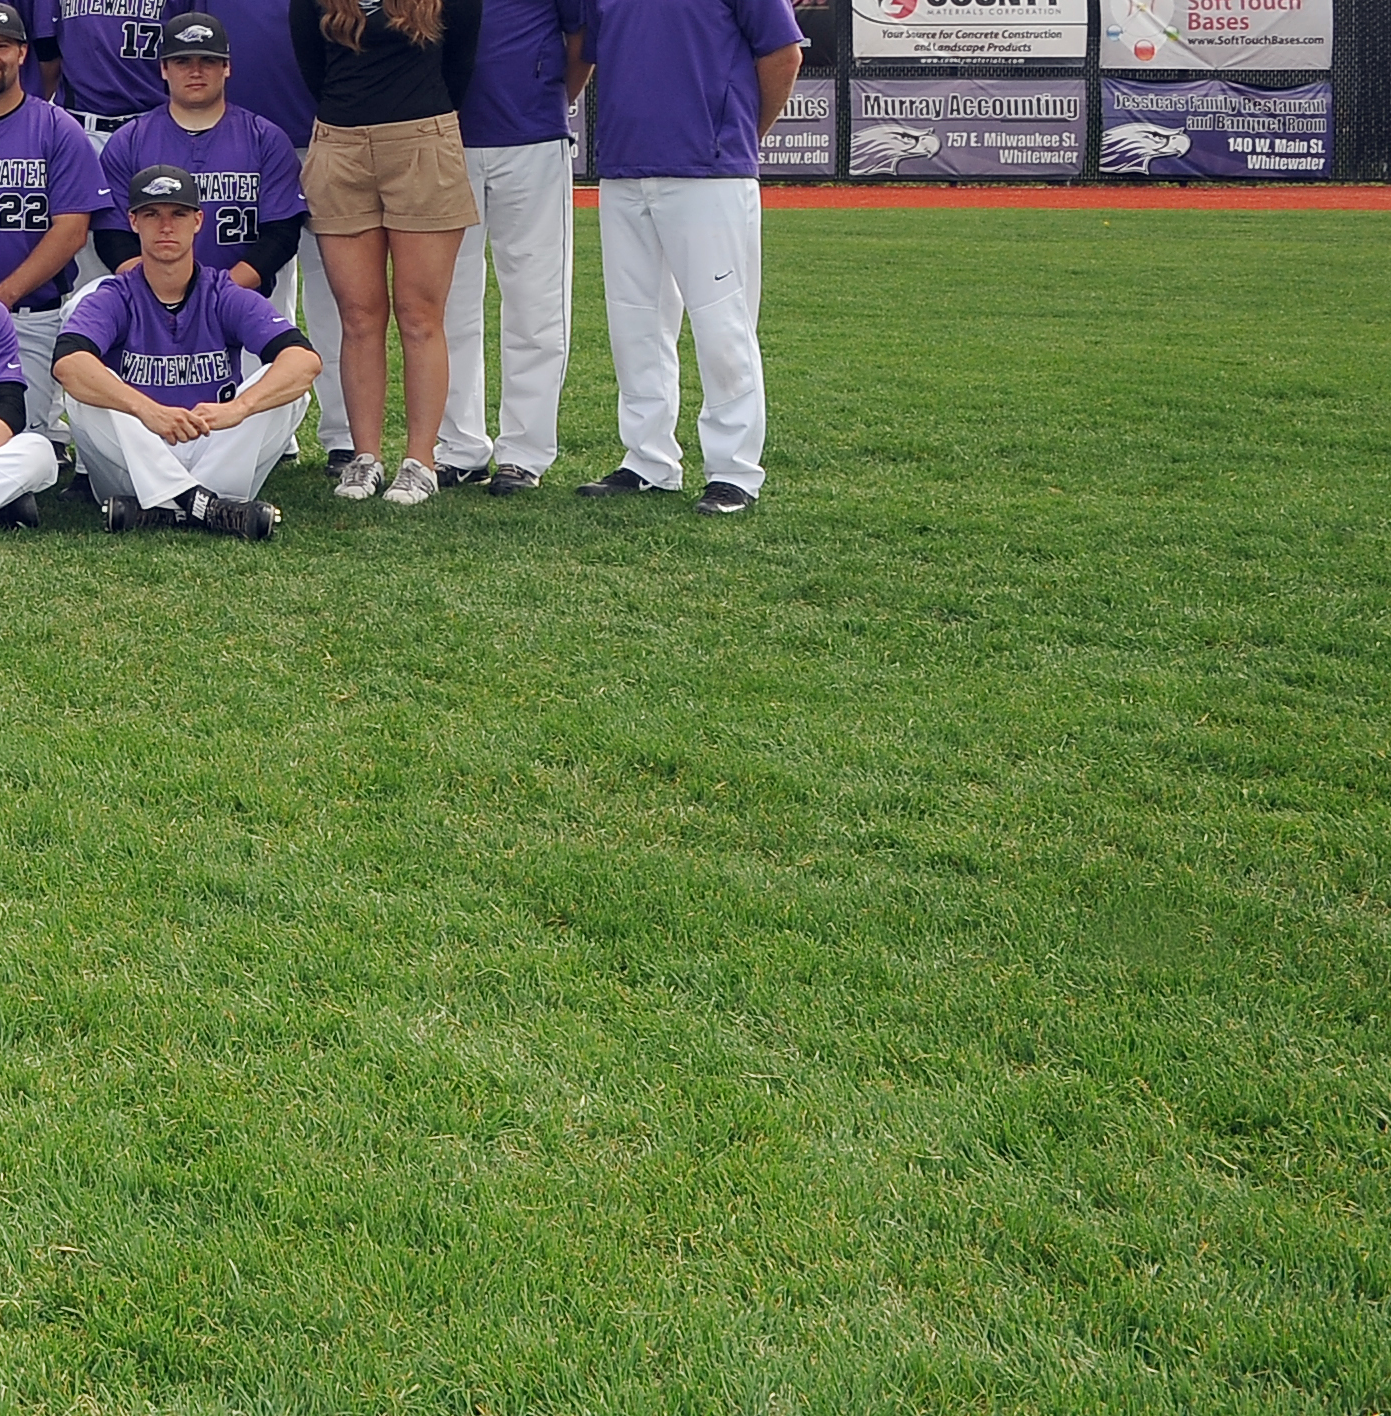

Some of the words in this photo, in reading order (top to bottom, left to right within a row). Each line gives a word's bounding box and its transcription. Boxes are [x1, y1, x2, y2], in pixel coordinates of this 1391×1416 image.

[1187, 12, 1249, 31] Bases
[120, 21, 163, 60] 17
[881, 29, 904, 40] Your
[906, 30, 937, 40] Source
[938, 30, 952, 41] for
[955, 29, 1000, 40] Concrete
[1001, 29, 1062, 40] Construction
[1187, 35, 1324, 46] www.SoftTouchBases.com
[913, 42, 931, 52] and
[932, 43, 986, 54] Landscape
[987, 42, 1032, 52] Products
[862, 93, 942, 121] Murray
[948, 93, 1080, 121] Accounting
[1114, 93, 1186, 111] Jessica's
[1188, 95, 1237, 114] Family
[1241, 97, 1327, 115] Restaurant
[1186, 114, 1212, 131] and
[1216, 115, 1284, 133] Banquet
[1287, 117, 1327, 133] Room
[785, 133, 829, 147] online
[946, 133, 968, 147] 757
[971, 133, 981, 147] E.
[984, 132, 1059, 147] Milwaukee
[1062, 133, 1079, 147] St.
[1227, 137, 1250, 152] 140
[1255, 138, 1272, 153] W.
[1274, 138, 1308, 154] Main
[1310, 139, 1326, 154] St.
[999, 149, 1078, 164] Whitewater
[1247, 154, 1326, 170] Whitewater
[216, 205, 259, 246] 21
[191, 490, 210, 521] NIKE
